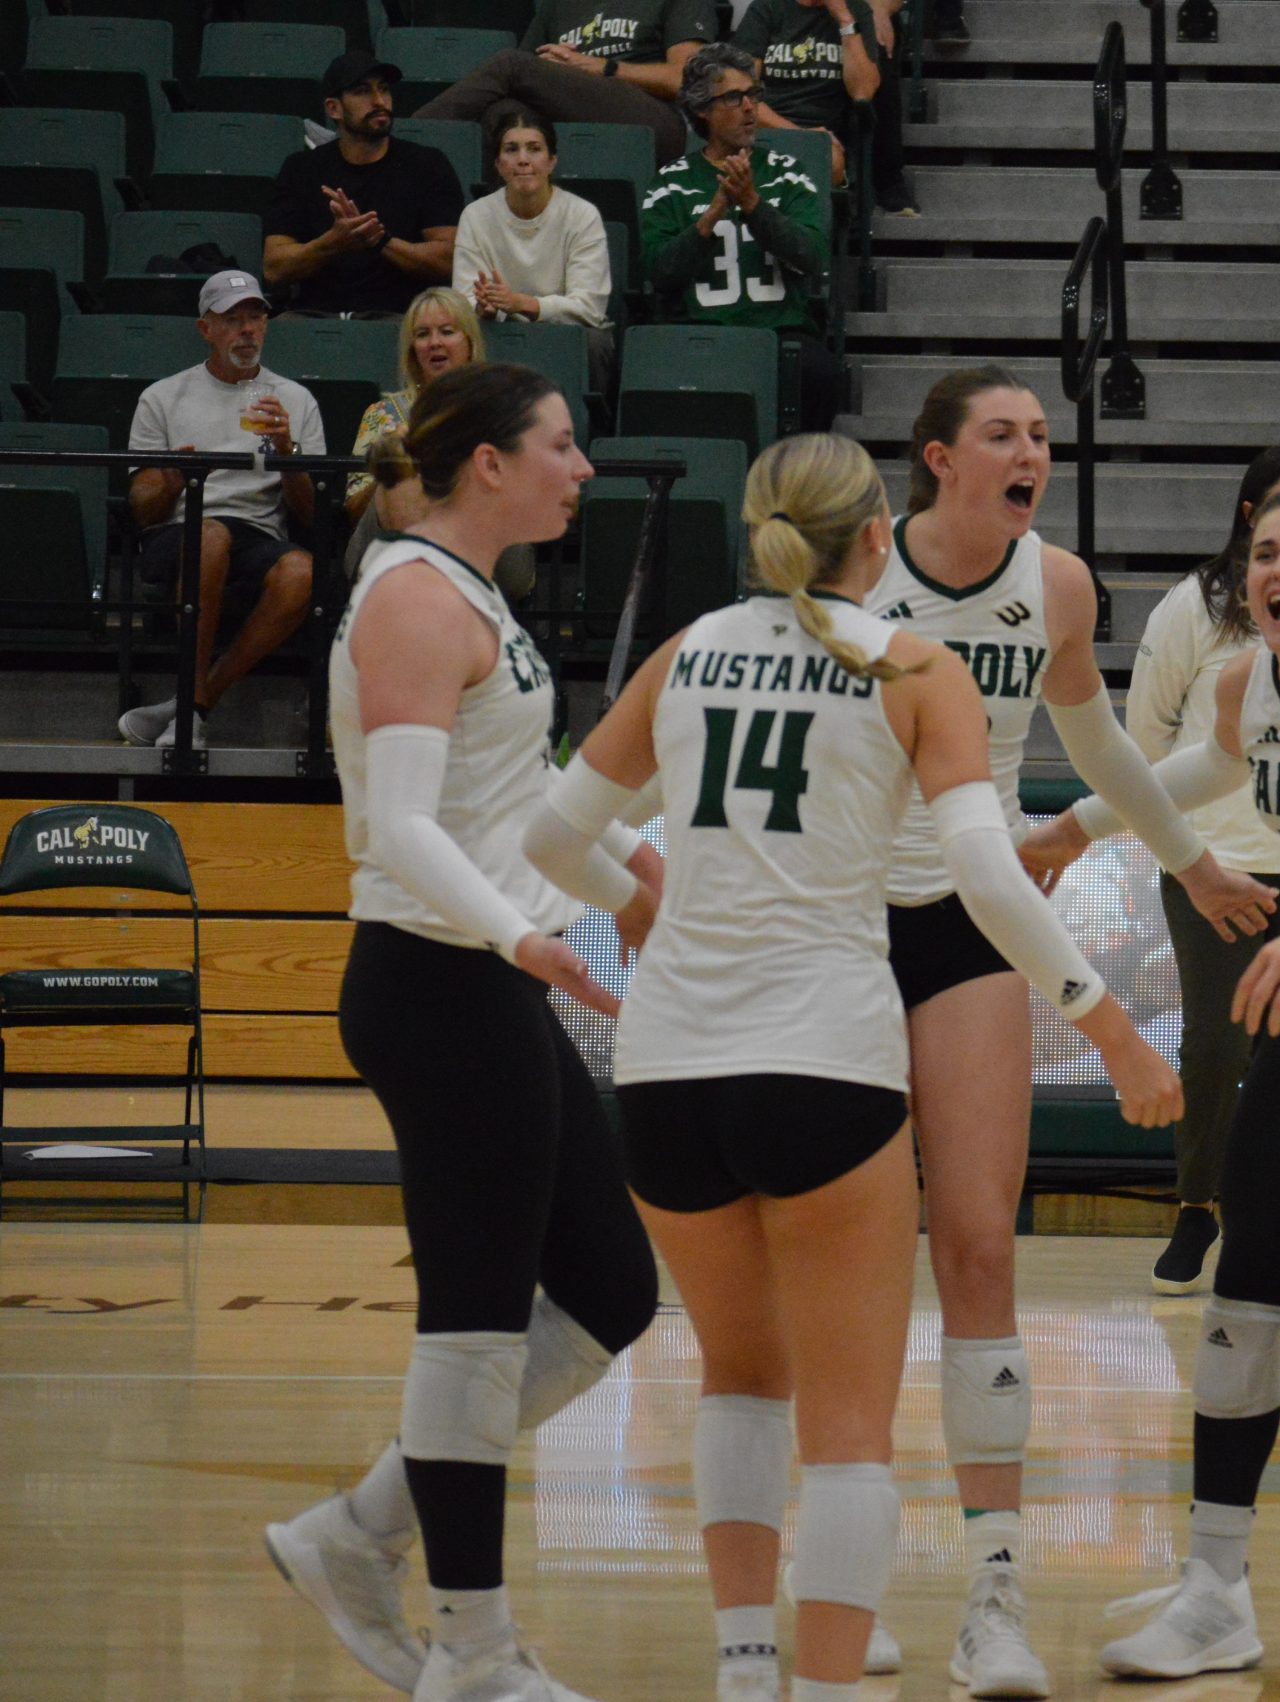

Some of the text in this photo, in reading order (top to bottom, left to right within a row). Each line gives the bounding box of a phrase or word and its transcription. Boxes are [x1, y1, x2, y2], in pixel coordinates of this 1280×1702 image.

[600, 18, 639, 39] POLY
[763, 42, 843, 64] CAL PO
[765, 66, 842, 79] VOLLEYBAL
[689, 706, 817, 834] 14
[37, 825, 150, 853] CAL POLY
[54, 855, 134, 865] MUSTANGS
[43, 976, 159, 988] WWW.GOPOLY.COM
